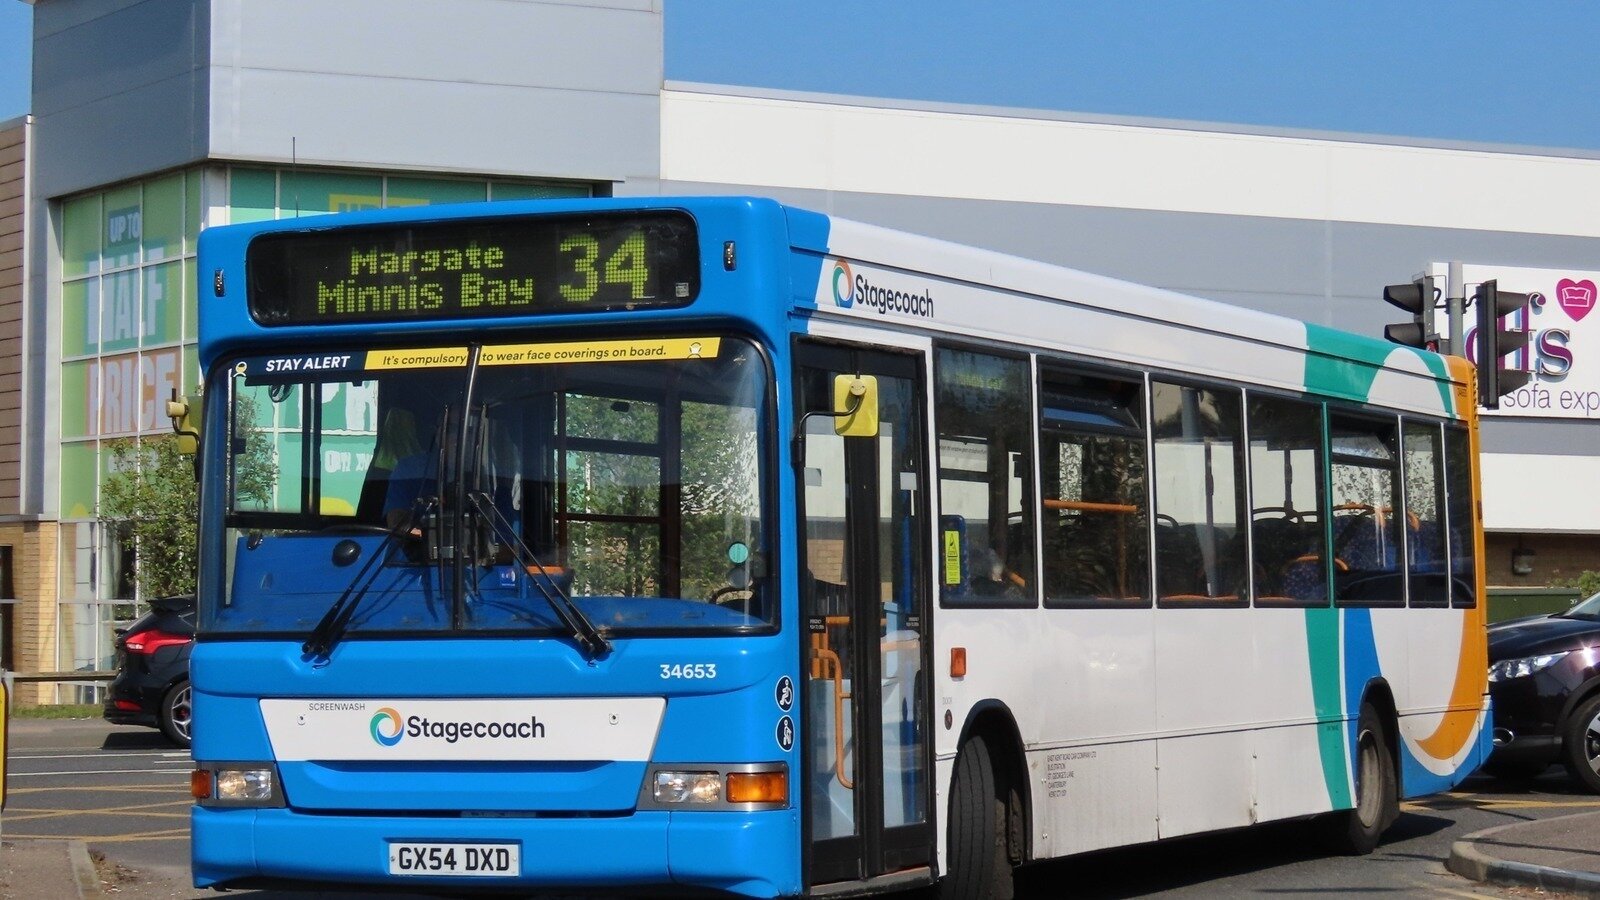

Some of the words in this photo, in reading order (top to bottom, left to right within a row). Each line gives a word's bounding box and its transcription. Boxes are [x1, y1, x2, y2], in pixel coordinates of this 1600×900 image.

[110, 215, 127, 243] UP
[127, 211, 141, 240] TO
[351, 243, 504, 275] Margate
[560, 232, 648, 301] 34
[87, 247, 164, 343] HALF
[318, 276, 443, 314] Minnis
[461, 273, 533, 307] Bay
[855, 274, 934, 318] Stagecoach
[265, 358, 302, 372] STAY
[303, 355, 351, 370] ALERT
[383, 355, 401, 366] It's
[402, 354, 467, 366] compulsory
[482, 351, 494, 361] to
[496, 352, 524, 361] wear
[527, 349, 551, 360] face
[554, 347, 609, 360] coverings
[612, 349, 627, 358] on
[629, 345, 667, 357] board.
[89, 353, 176, 434] PRICE
[1504, 383, 1551, 409] sofa
[659, 663, 717, 679] 34653
[308, 702, 366, 711] SCREENWASH
[407, 715, 546, 743] Stagecoach
[399, 847, 457, 871] GX54
[465, 848, 510, 871] DXD
